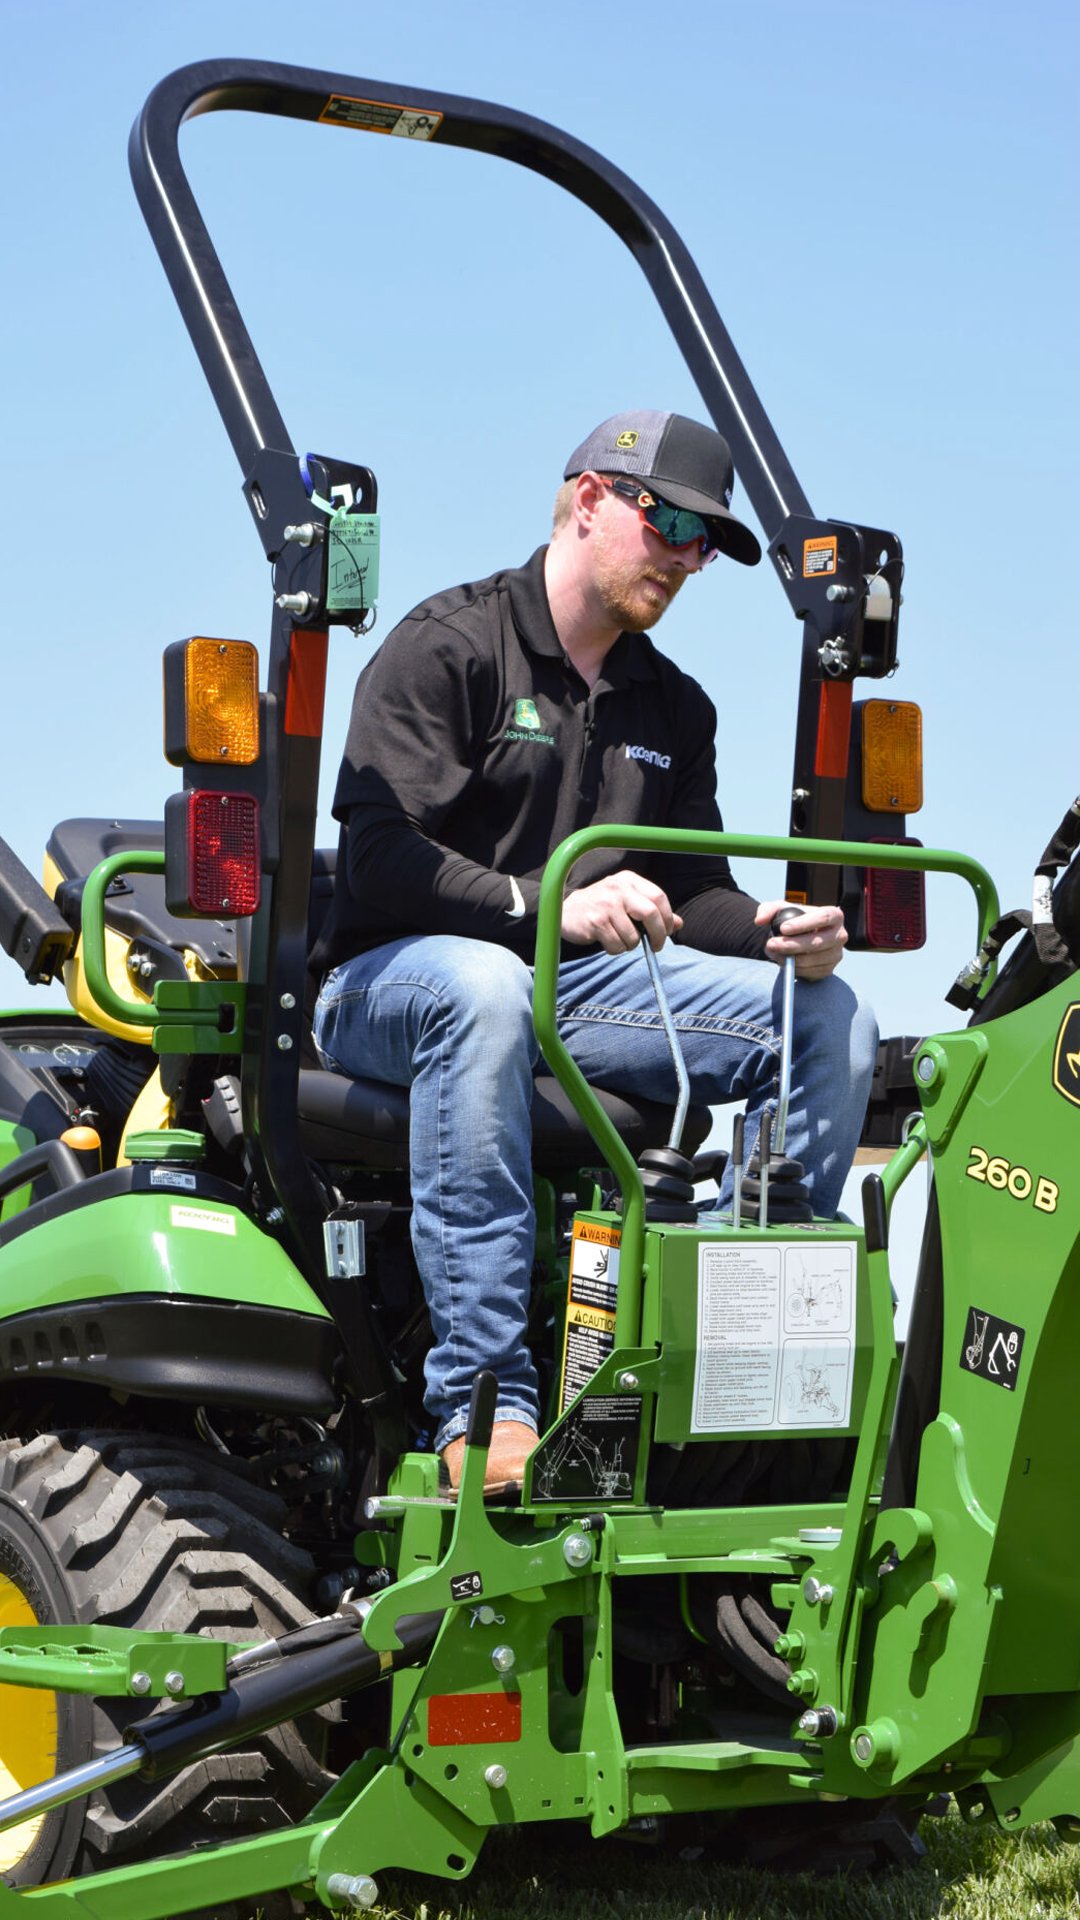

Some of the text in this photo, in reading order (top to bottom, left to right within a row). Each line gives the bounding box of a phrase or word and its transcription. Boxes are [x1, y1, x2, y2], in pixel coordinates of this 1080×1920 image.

[504, 730, 528, 740] JOHN
[966, 1146, 1059, 1214] 260 B
[588, 1228, 621, 1247] WARNIN
